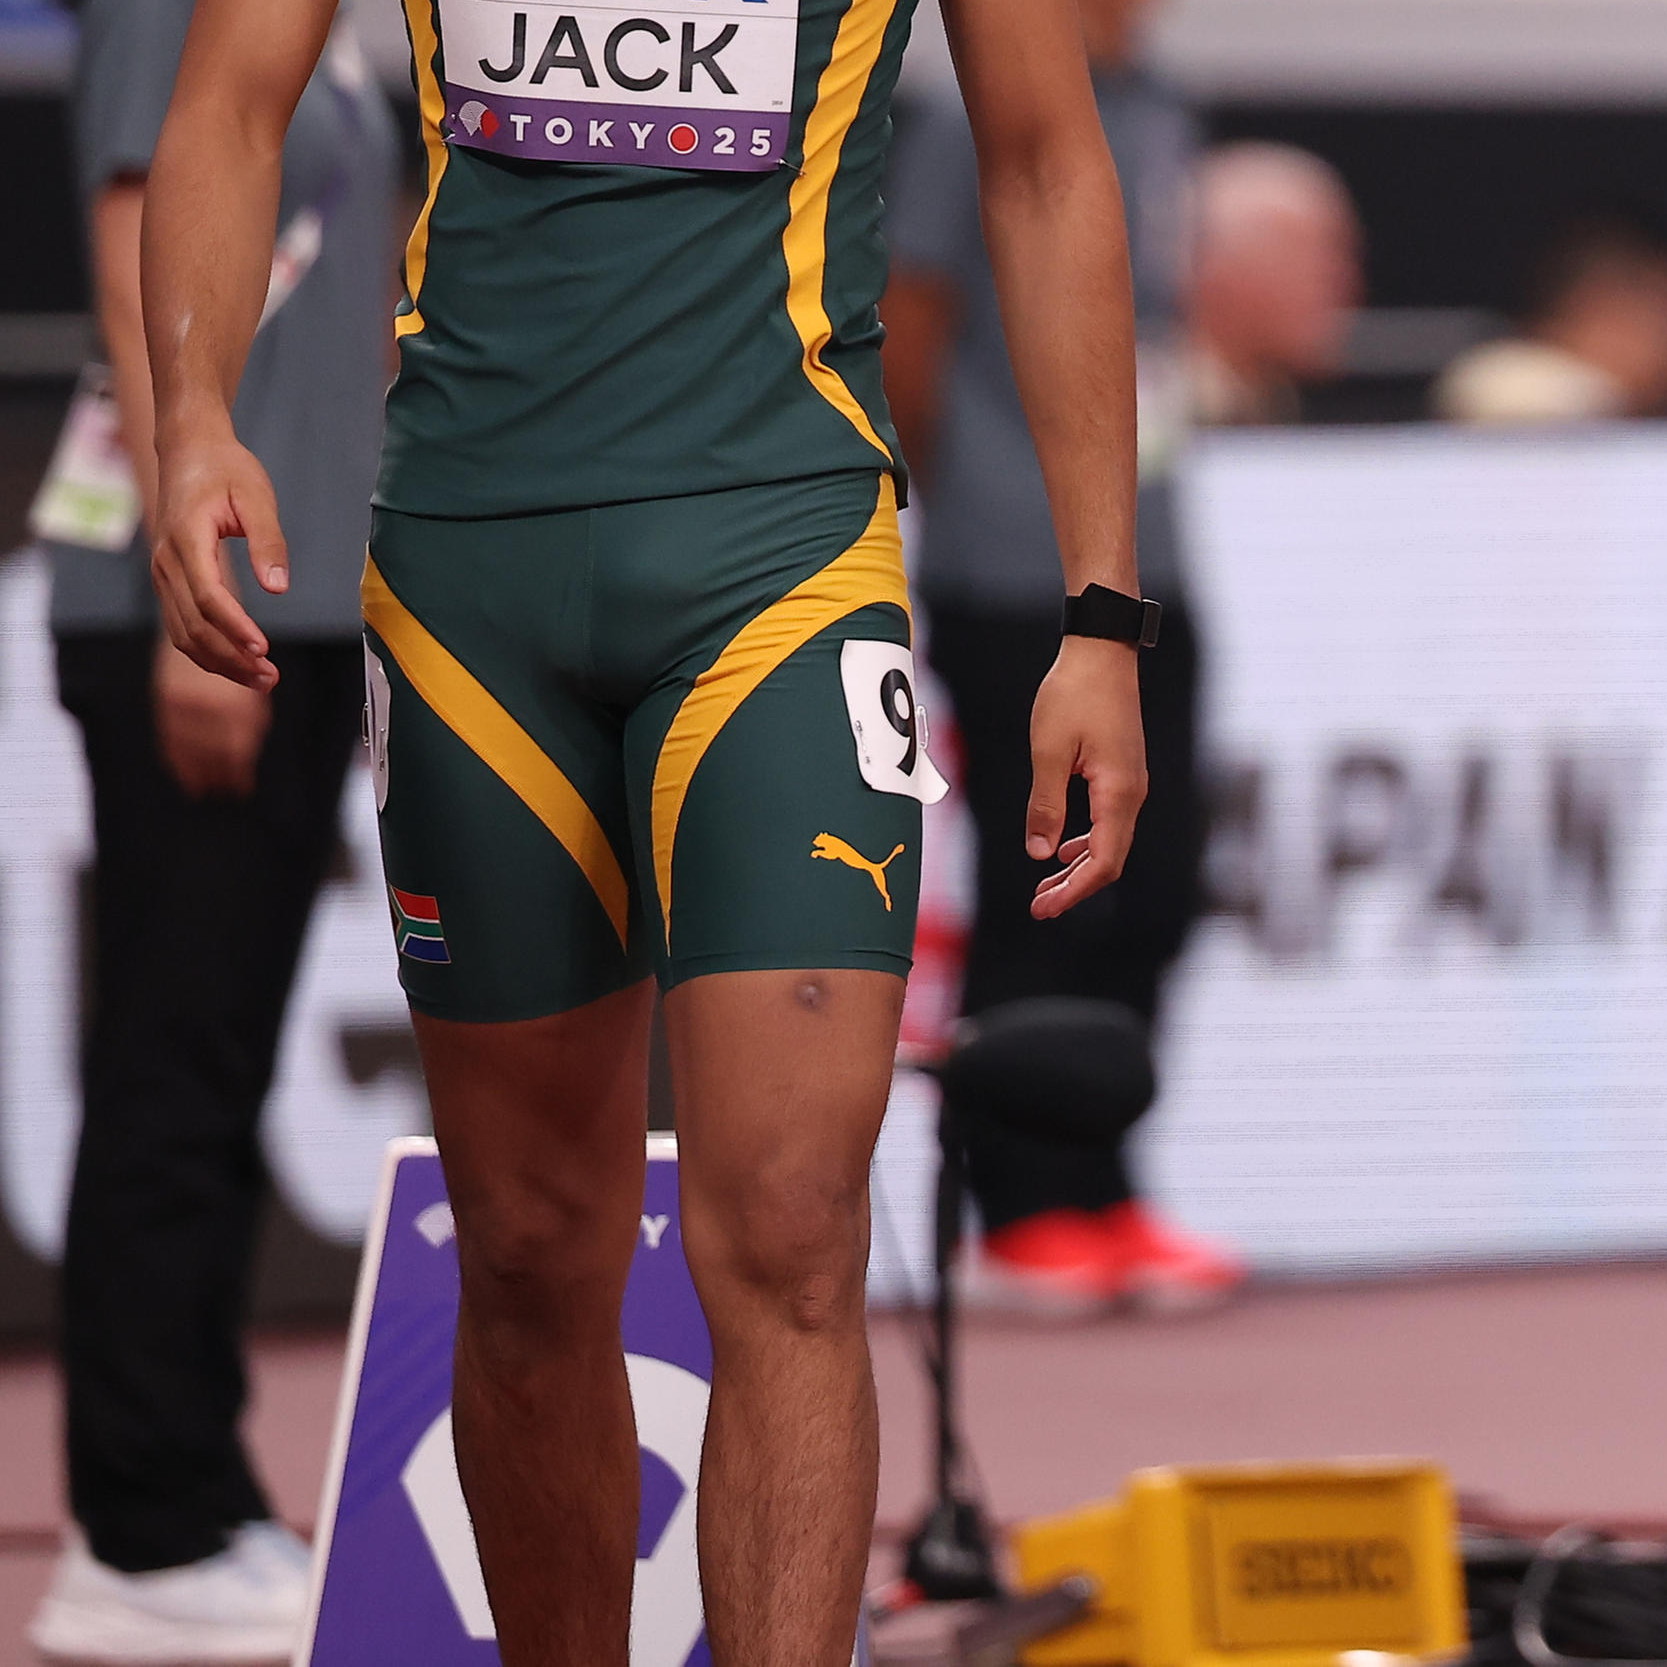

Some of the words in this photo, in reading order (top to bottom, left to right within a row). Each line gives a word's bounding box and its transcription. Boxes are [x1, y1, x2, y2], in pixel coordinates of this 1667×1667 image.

[477, 12, 740, 96] JACK
[880, 668, 918, 777] 9
[1200, 739, 1625, 954] APAN
